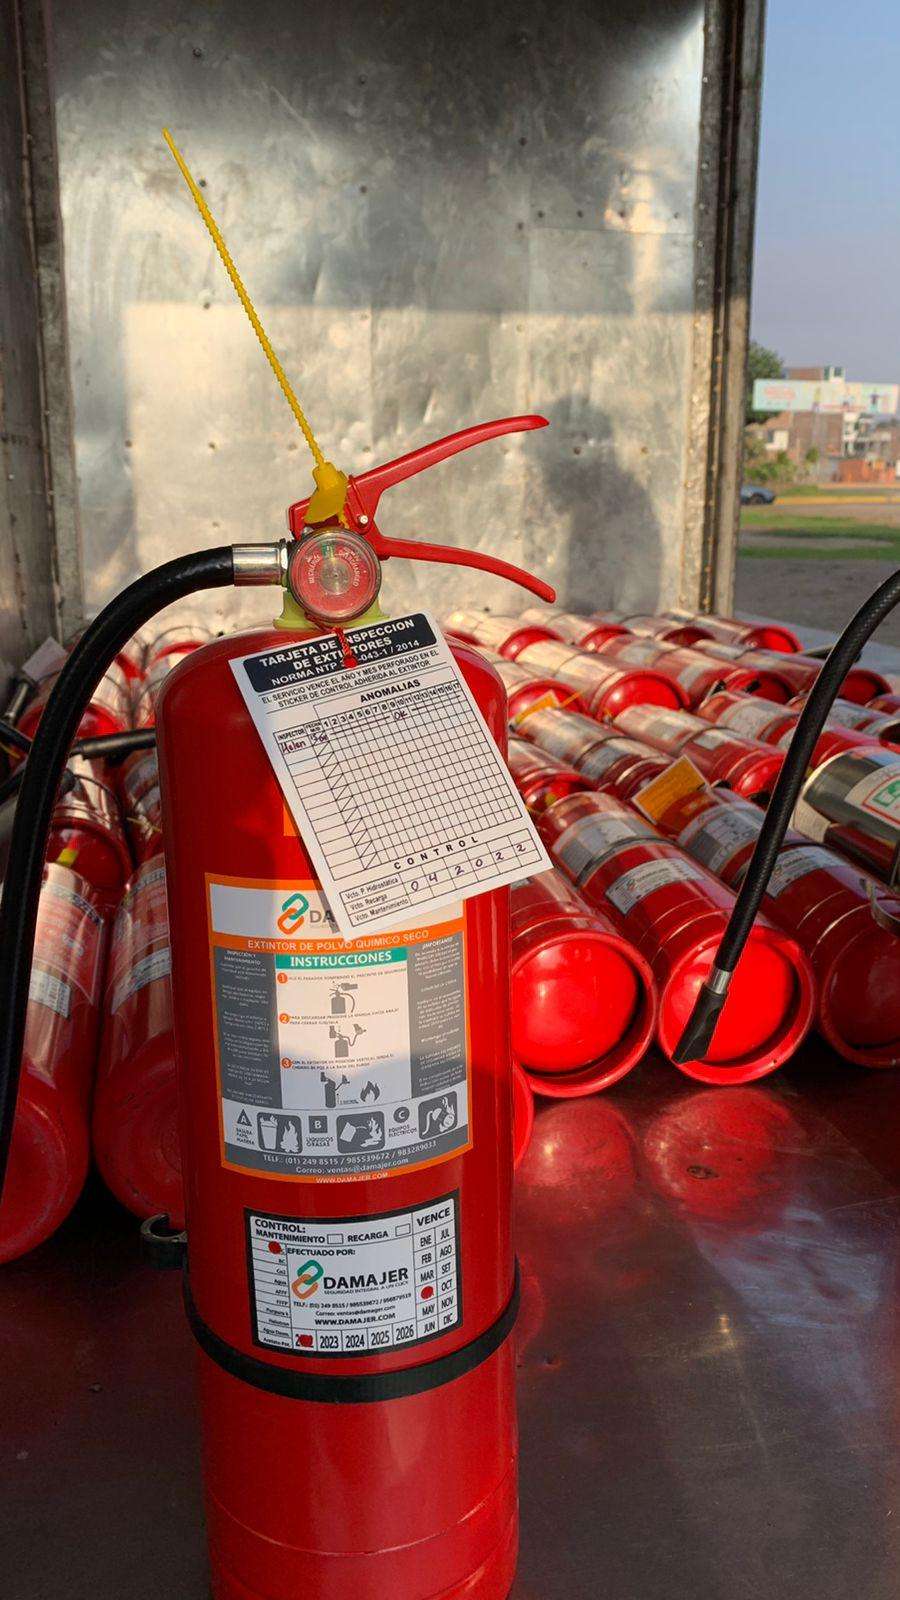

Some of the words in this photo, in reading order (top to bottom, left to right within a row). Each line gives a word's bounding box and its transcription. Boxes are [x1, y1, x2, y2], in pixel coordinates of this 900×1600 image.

[259, 646, 318, 667] TARJETA
[319, 640, 338, 650] DE
[345, 619, 415, 643] NSPECCION
[293, 658, 312, 670] DE
[313, 636, 392, 665] EXTITORES
[271, 669, 315, 686] NORMA
[315, 662, 338, 674] NTP
[396, 640, 420, 651] 2014
[261, 696, 272, 704] EL
[272, 686, 306, 701] SERVICIO
[306, 679, 330, 691] VENCE
[362, 666, 378, 675] MES
[377, 656, 419, 671] PERFORADO
[430, 649, 439, 657] EL
[278, 694, 309, 708] STICKER
[310, 691, 320, 699] DE
[320, 682, 353, 696] CONTROL
[354, 672, 388, 686] ADHERIDA
[388, 669, 398, 677] AL
[398, 660, 431, 674] EXTINTOR
[360, 679, 421, 703] ANOMALIAS
[394, 836, 479, 869] CONTROL
[247, 940, 297, 950] EXTINTOR
[300, 942, 314, 950] DE
[317, 941, 353, 950] POLVO
[402, 930, 429, 941] SECO
[290, 951, 392, 967] INSTRUCCIONES
[240, 1115, 247, 1123] A
[314, 1120, 322, 1129] B
[398, 1110, 405, 1119] C
[255, 1219, 306, 1233] CONTROL:
[416, 1207, 450, 1226] VENCE
[255, 1229, 325, 1243] MANTENIMIENTO
[347, 1230, 389, 1242] RECARGA
[420, 1234, 432, 1247] ENE
[440, 1228, 450, 1240] JUL
[287, 1248, 335, 1256] EFECTUADO
[336, 1248, 356, 1256] POR:
[421, 1253, 432, 1264] FEB
[439, 1244, 452, 1258] AGO
[323, 1267, 409, 1289] DAMAJER
[420, 1270, 435, 1282] MAR
[441, 1262, 451, 1274] SET
[441, 1278, 453, 1291] OCT
[422, 1304, 435, 1316] MAY
[441, 1295, 454, 1309] NOV
[314, 1313, 396, 1325] WWW.DAMAJER.COM
[424, 1321, 436, 1333] JUN
[319, 1335, 339, 1348] 2023
[345, 1334, 365, 1348] 2024
[370, 1330, 390, 1346] 2025
[395, 1324, 415, 1341] 2026
